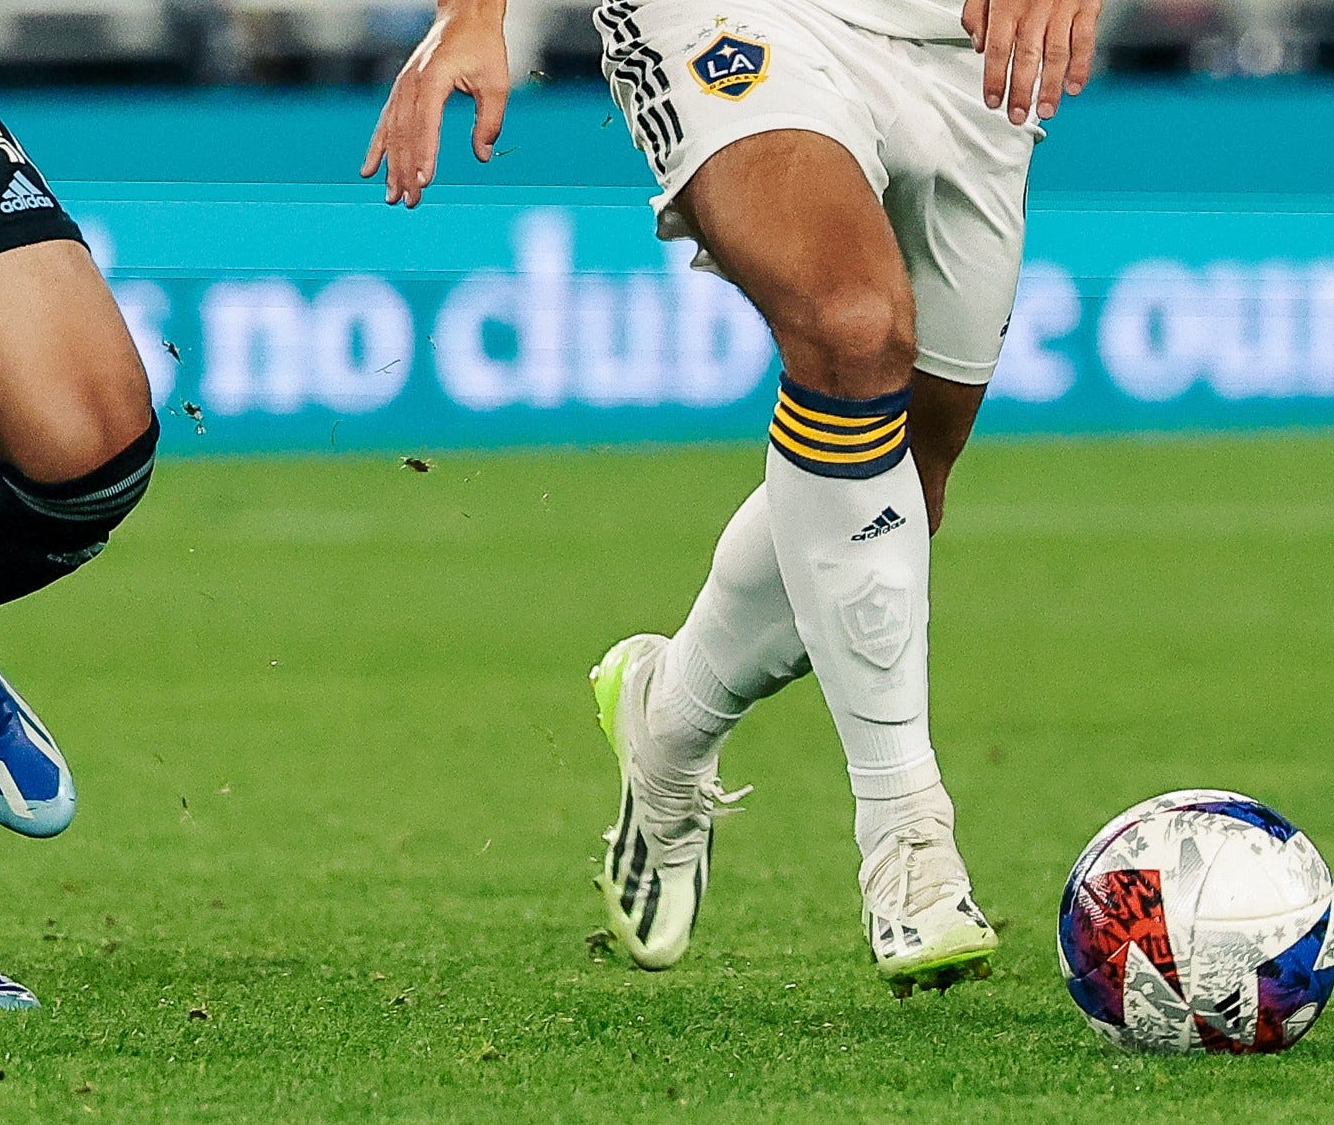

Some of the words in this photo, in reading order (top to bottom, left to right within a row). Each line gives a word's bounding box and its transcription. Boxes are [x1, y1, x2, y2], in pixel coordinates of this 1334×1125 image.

[706, 53, 756, 79] LA
[199, 273, 417, 415] no
[850, 517, 907, 542] adidas
